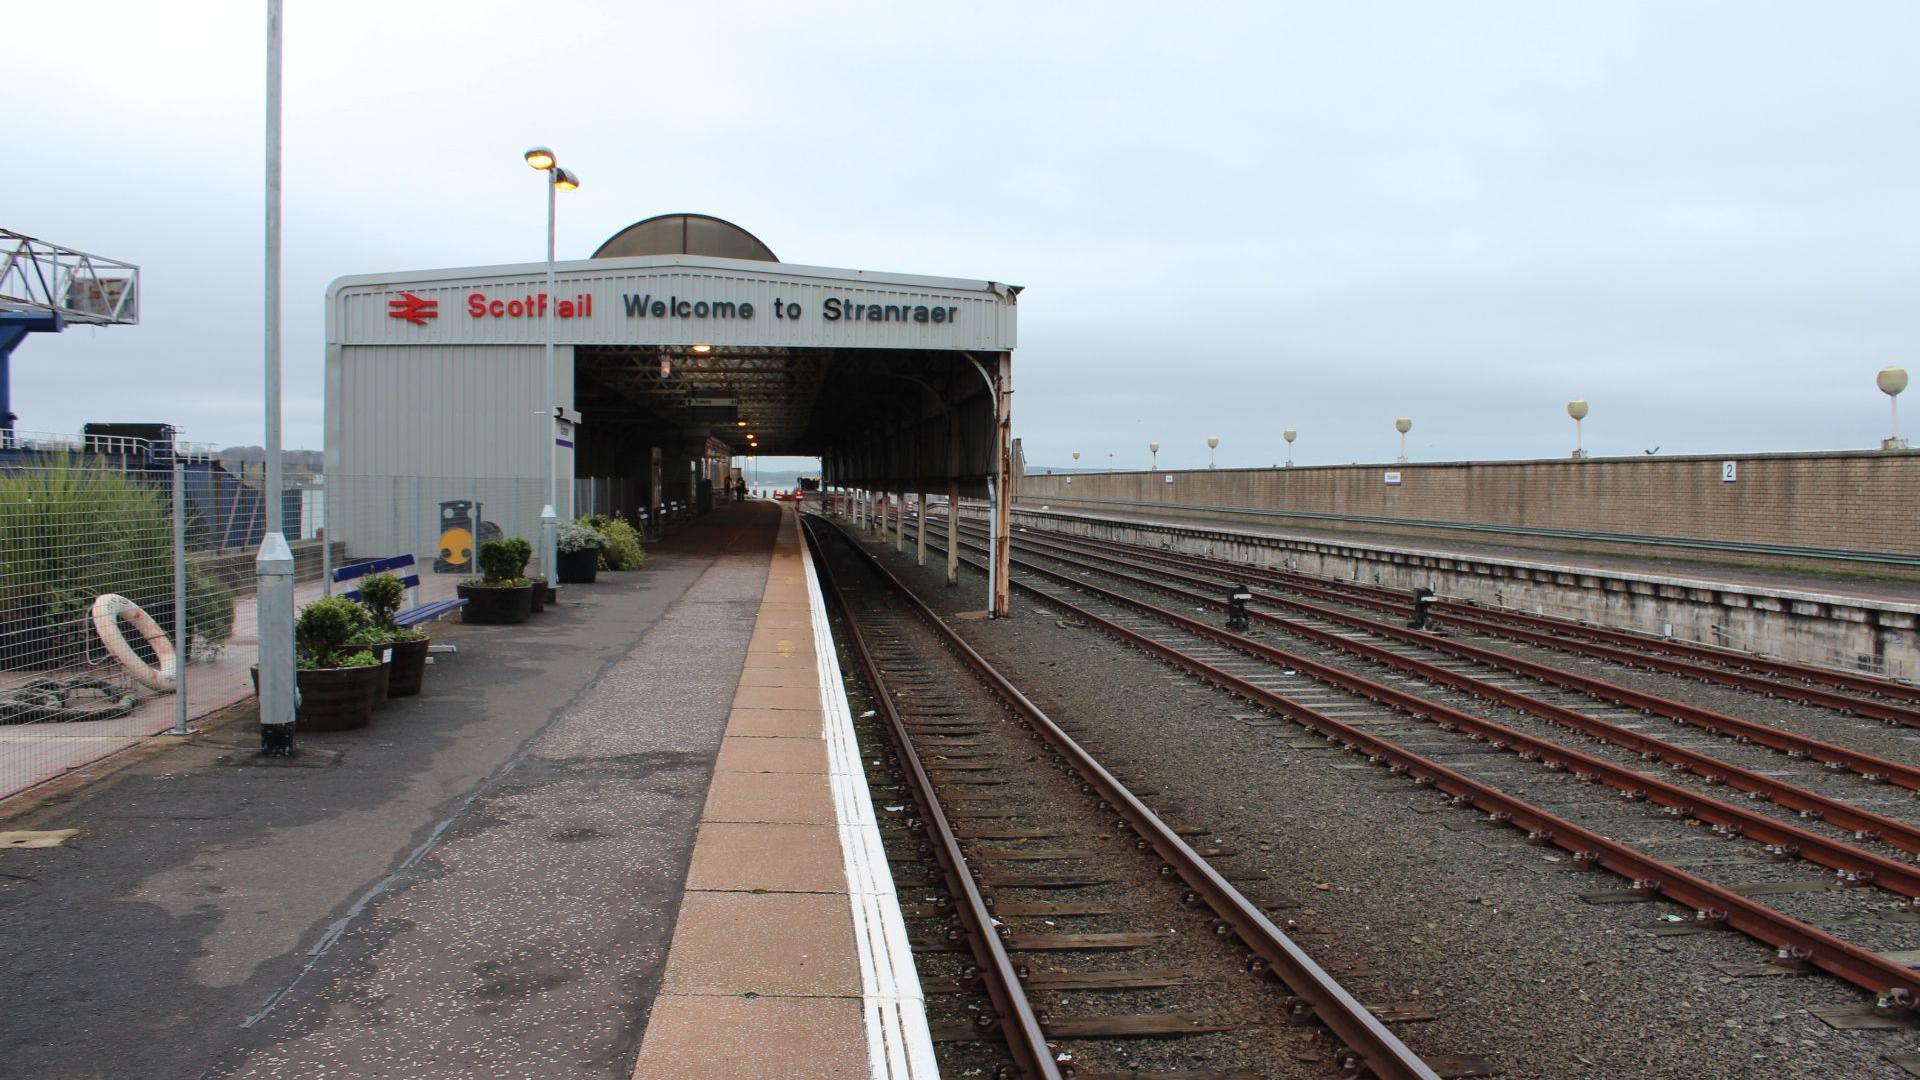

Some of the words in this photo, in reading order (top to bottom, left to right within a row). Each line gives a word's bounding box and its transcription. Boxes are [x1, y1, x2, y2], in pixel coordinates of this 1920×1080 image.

[623, 294, 754, 319] Welcome
[773, 297, 802, 319] to
[823, 297, 958, 323] Stranraer
[1726, 463, 1734, 478] 2
